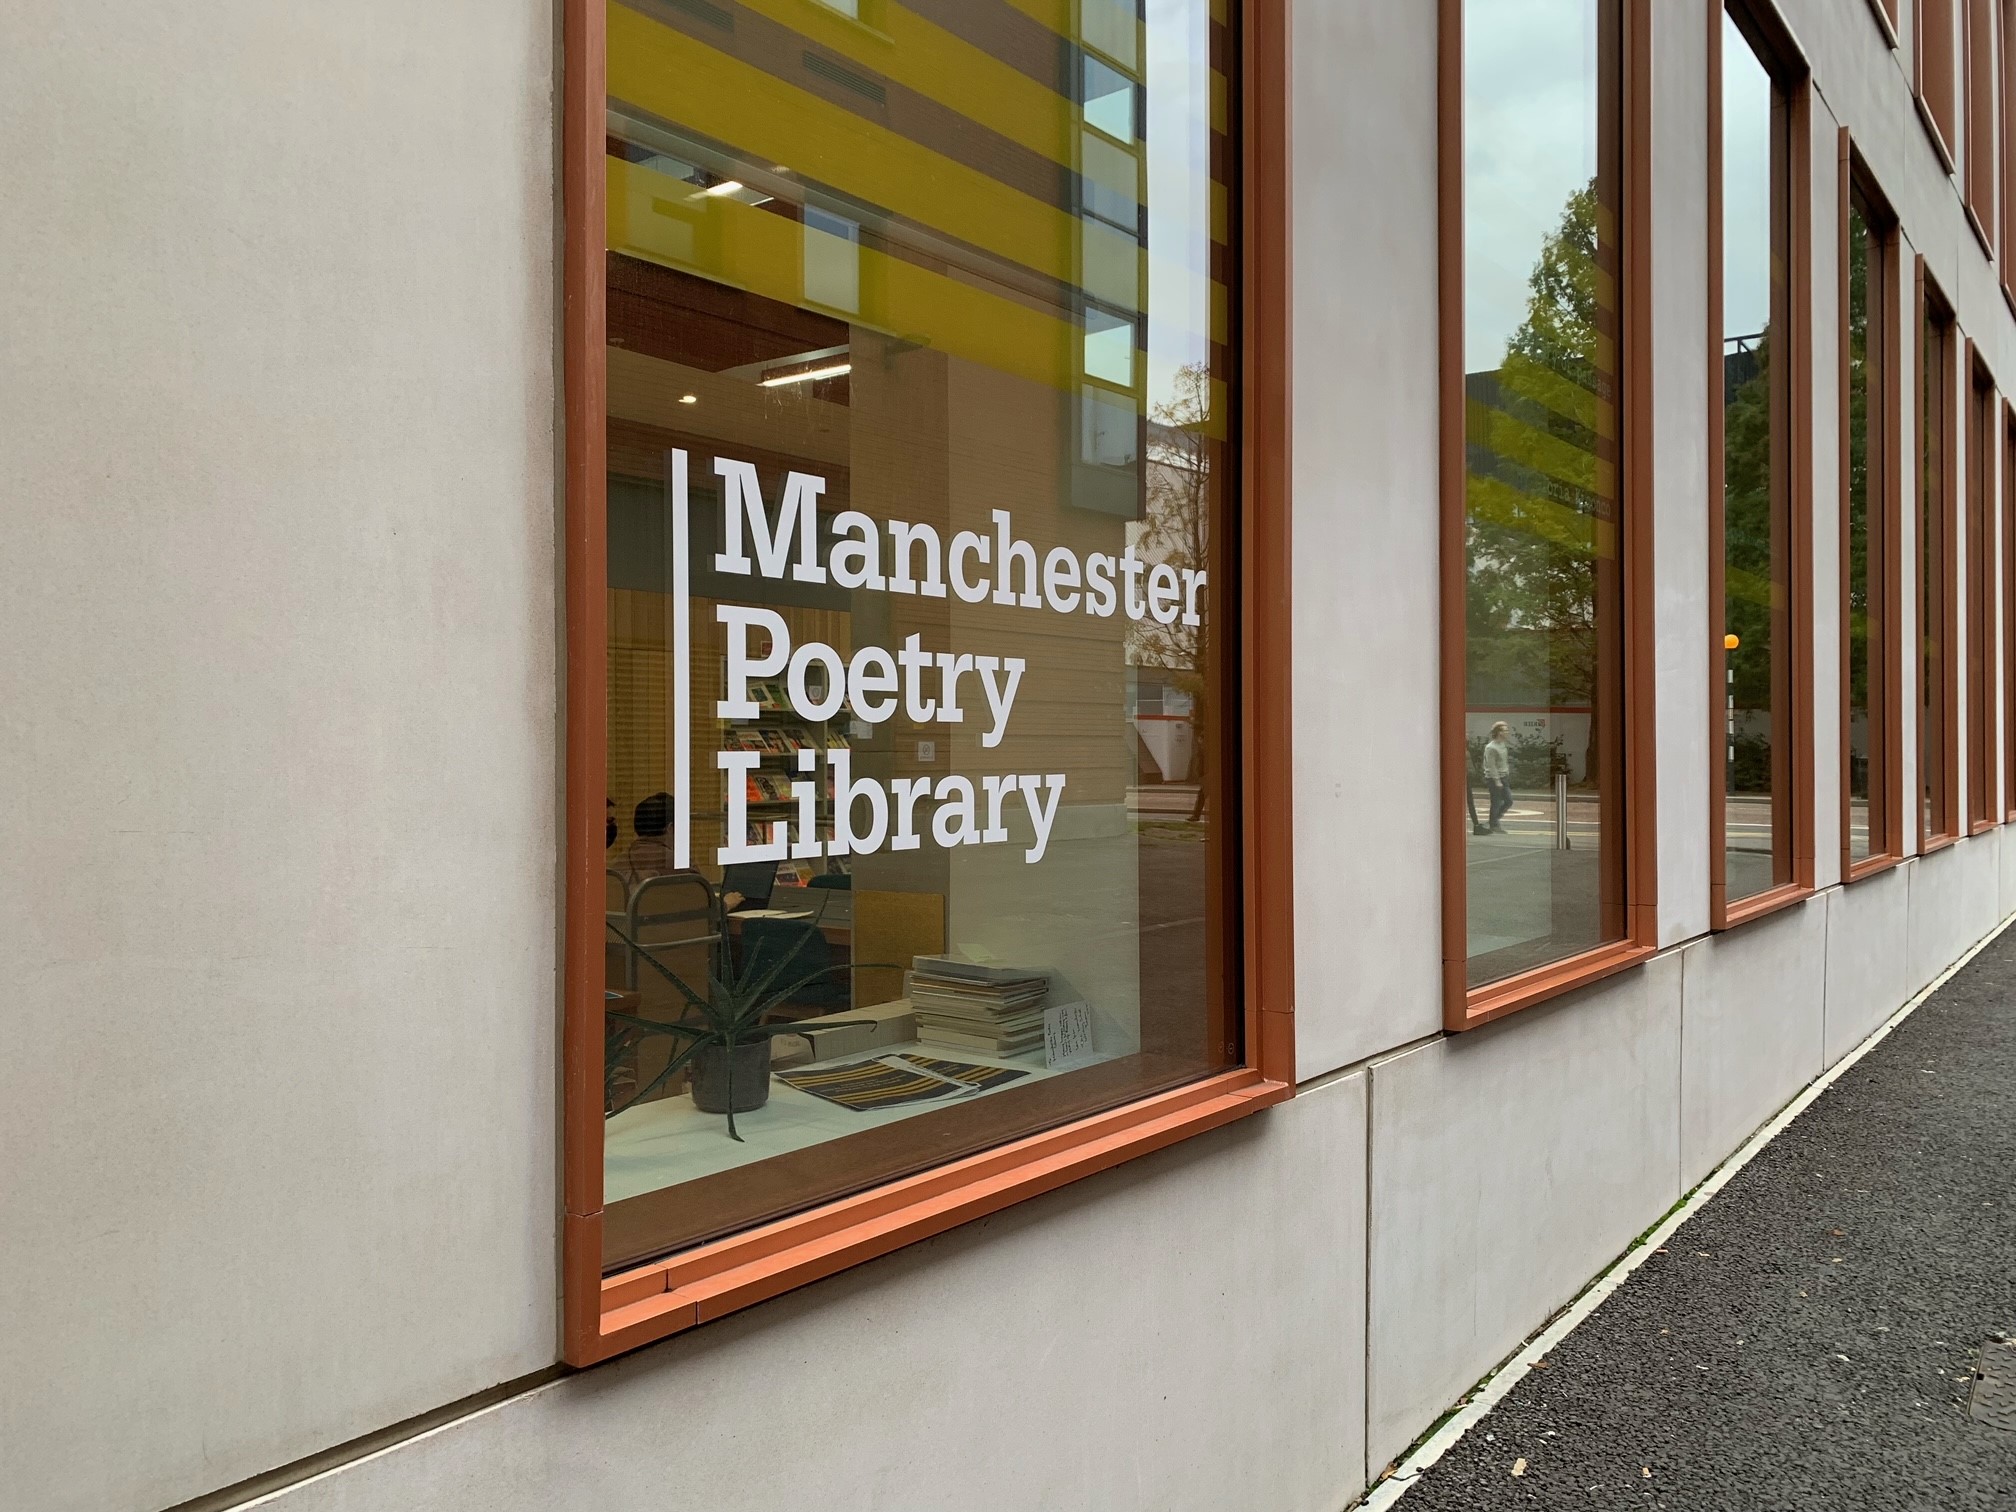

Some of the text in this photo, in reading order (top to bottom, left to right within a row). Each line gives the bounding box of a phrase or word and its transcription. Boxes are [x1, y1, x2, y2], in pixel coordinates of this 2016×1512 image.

[714, 456, 1207, 626] Manchester
[716, 604, 1026, 748] Poetry
[717, 748, 1066, 866] Library
